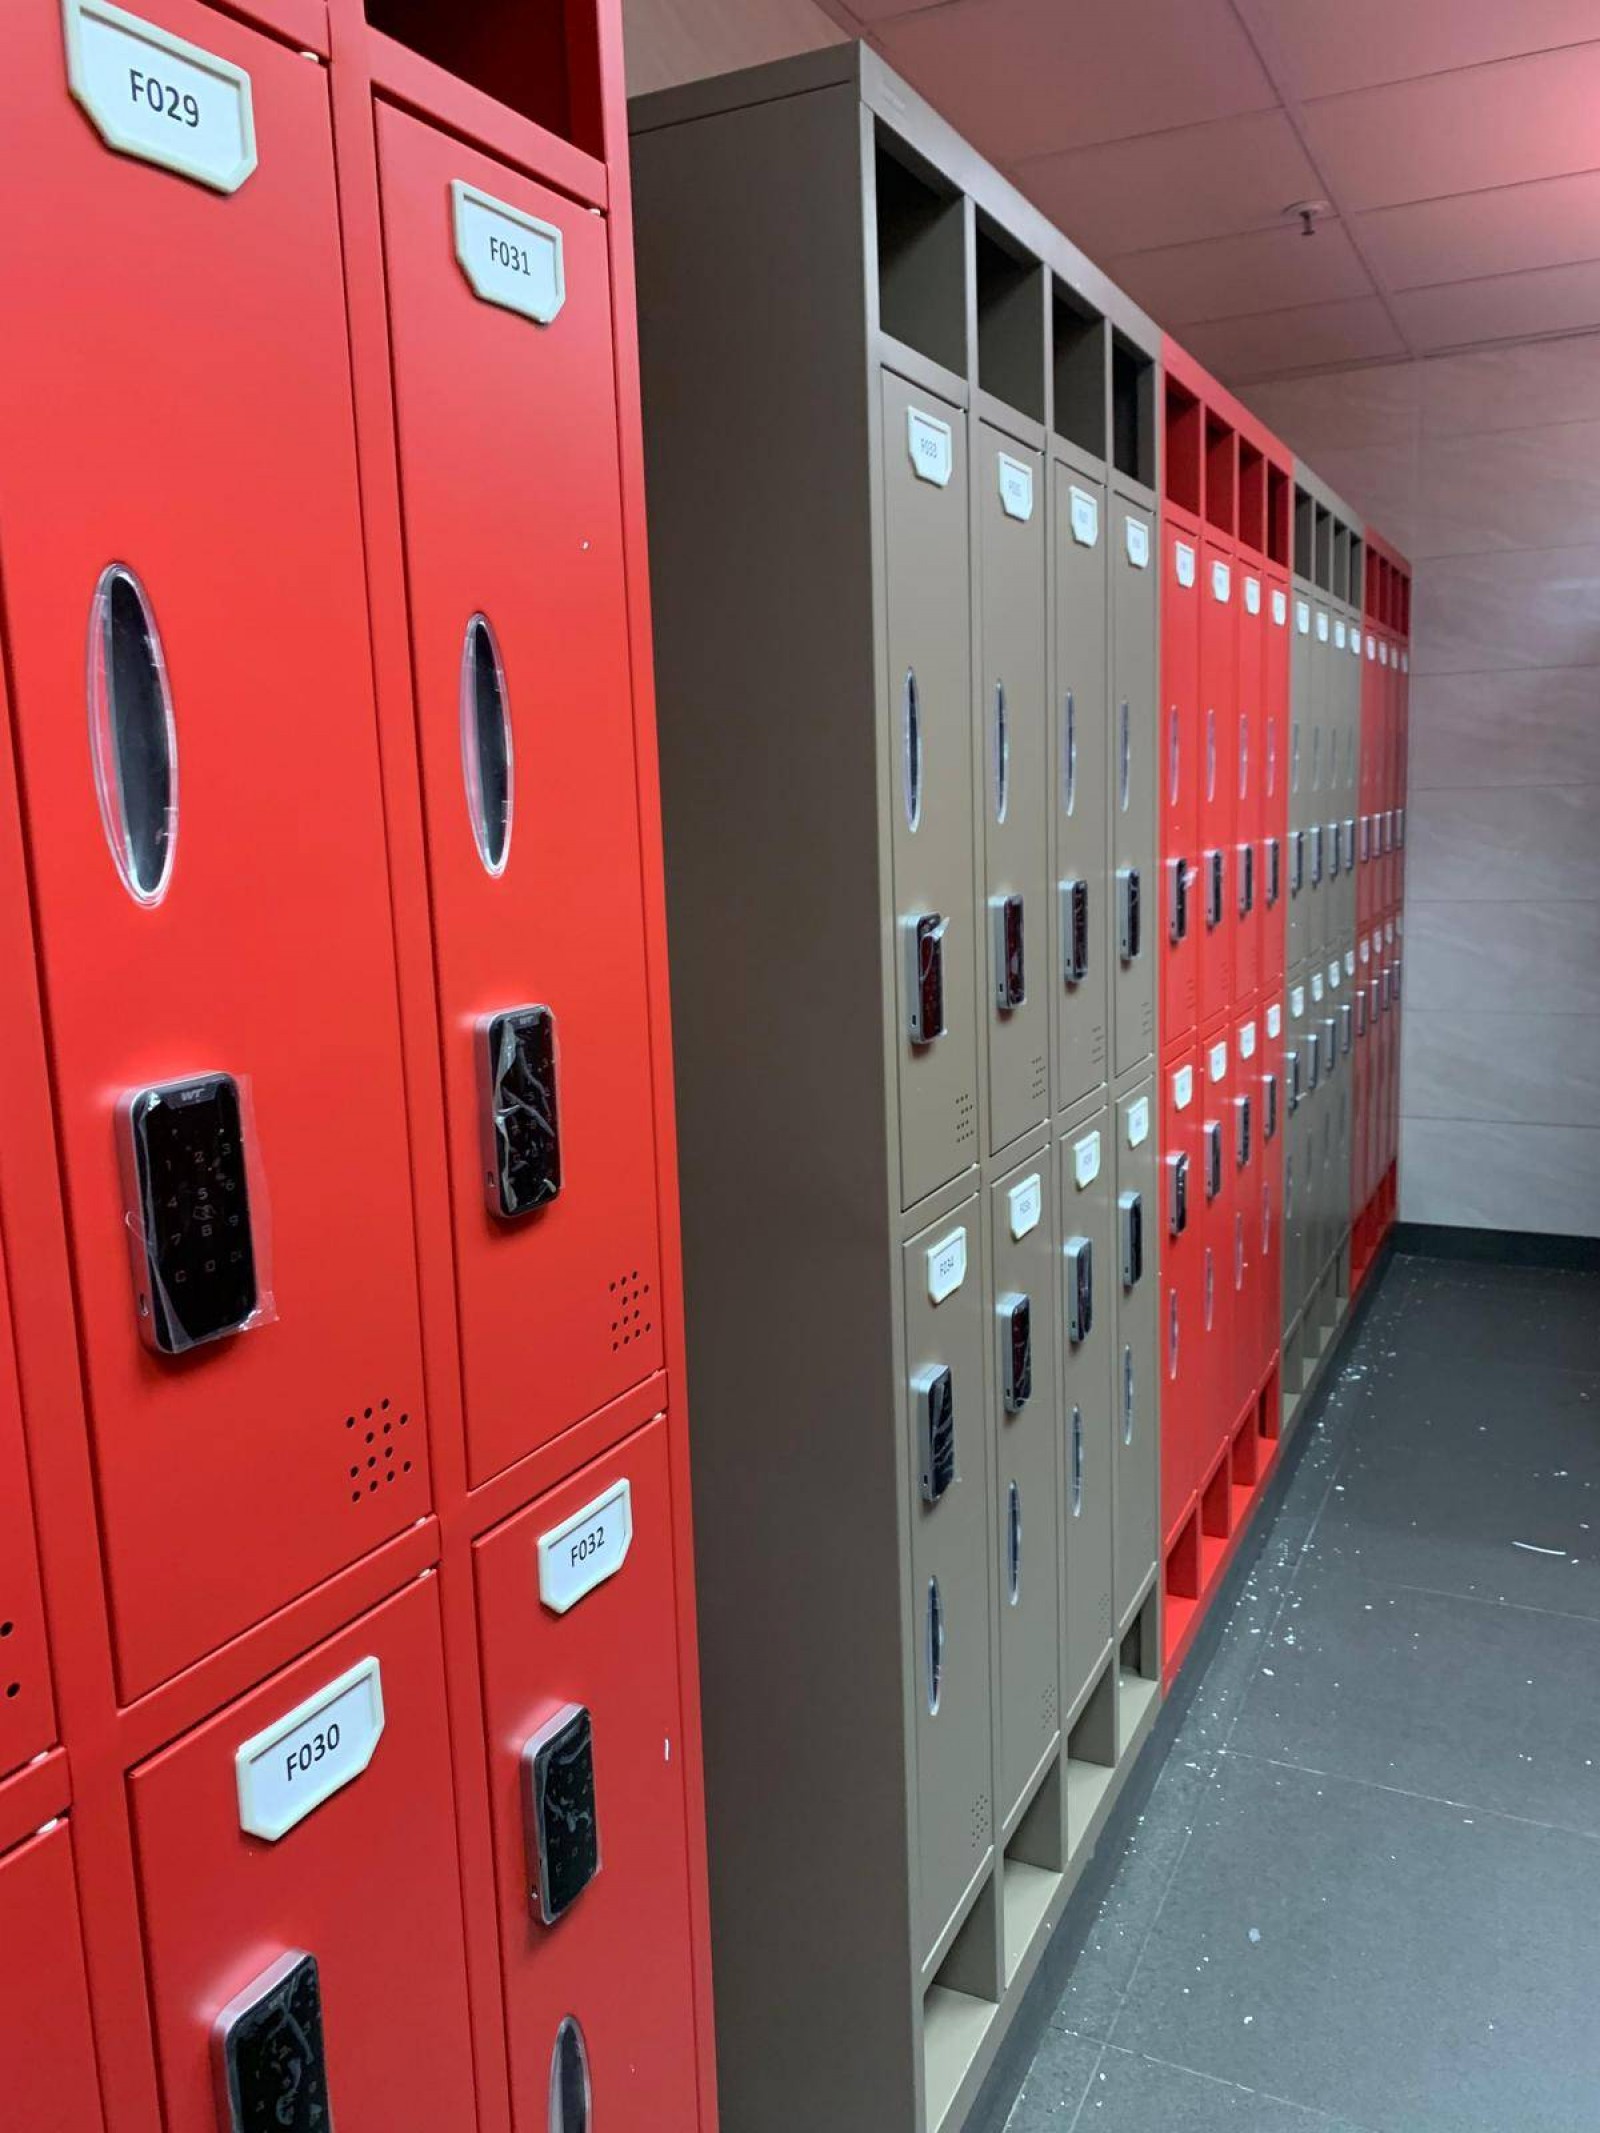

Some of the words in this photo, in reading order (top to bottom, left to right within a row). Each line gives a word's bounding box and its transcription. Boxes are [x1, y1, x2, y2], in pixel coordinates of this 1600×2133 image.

[129, 68, 200, 128] F029
[489, 236, 531, 276] F031
[194, 1151, 205, 1164] 2
[222, 1142, 233, 1155] 3
[167, 1195, 178, 1208] 4
[197, 1187, 208, 1200] 5
[225, 1178, 235, 1191] 6
[171, 1232, 182, 1246] 7
[201, 1224, 213, 1237] 8
[228, 1214, 239, 1227] 9
[570, 1526, 605, 1567] F032
[285, 1723, 340, 1781] F030
